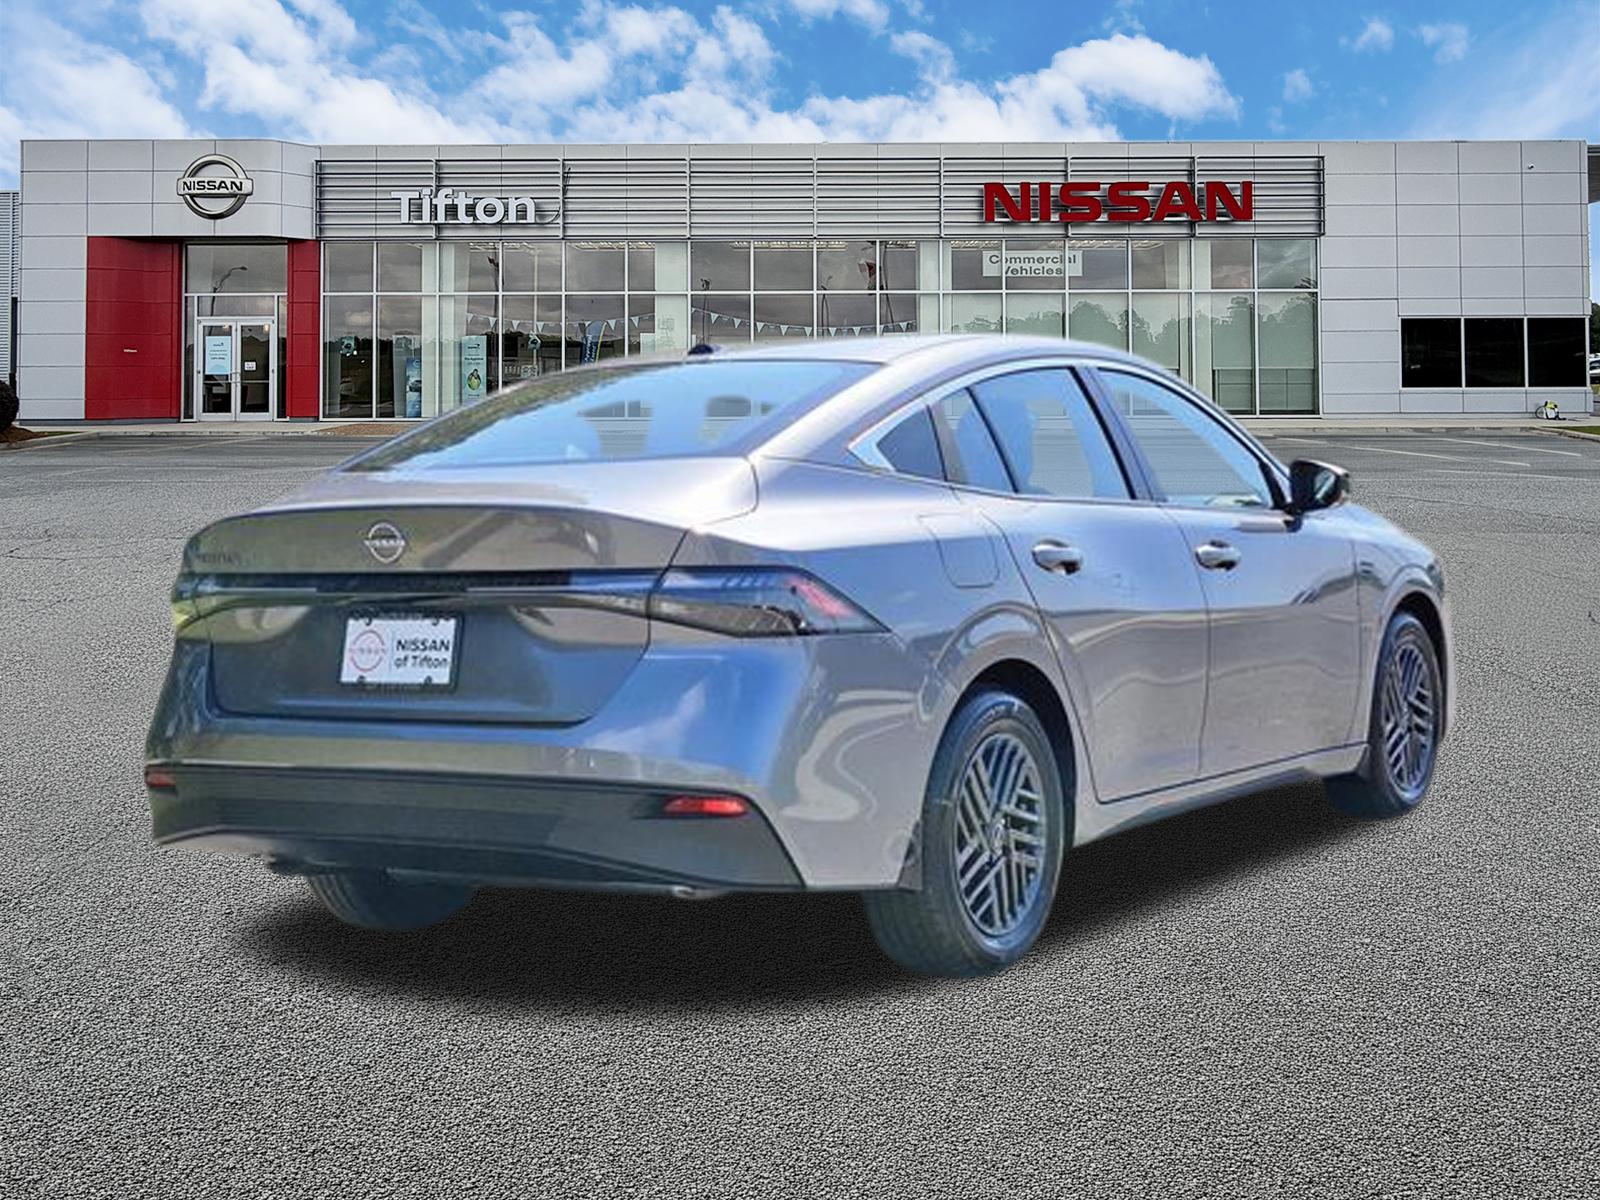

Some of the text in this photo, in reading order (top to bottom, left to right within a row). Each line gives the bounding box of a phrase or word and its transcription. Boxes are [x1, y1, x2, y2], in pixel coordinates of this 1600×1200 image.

[182, 180, 243, 191] NISSAN
[391, 187, 536, 224] Tifton
[983, 181, 1253, 222] NISSAN
[396, 638, 450, 651] NISSAN
[394, 655, 449, 669] of Tifton
